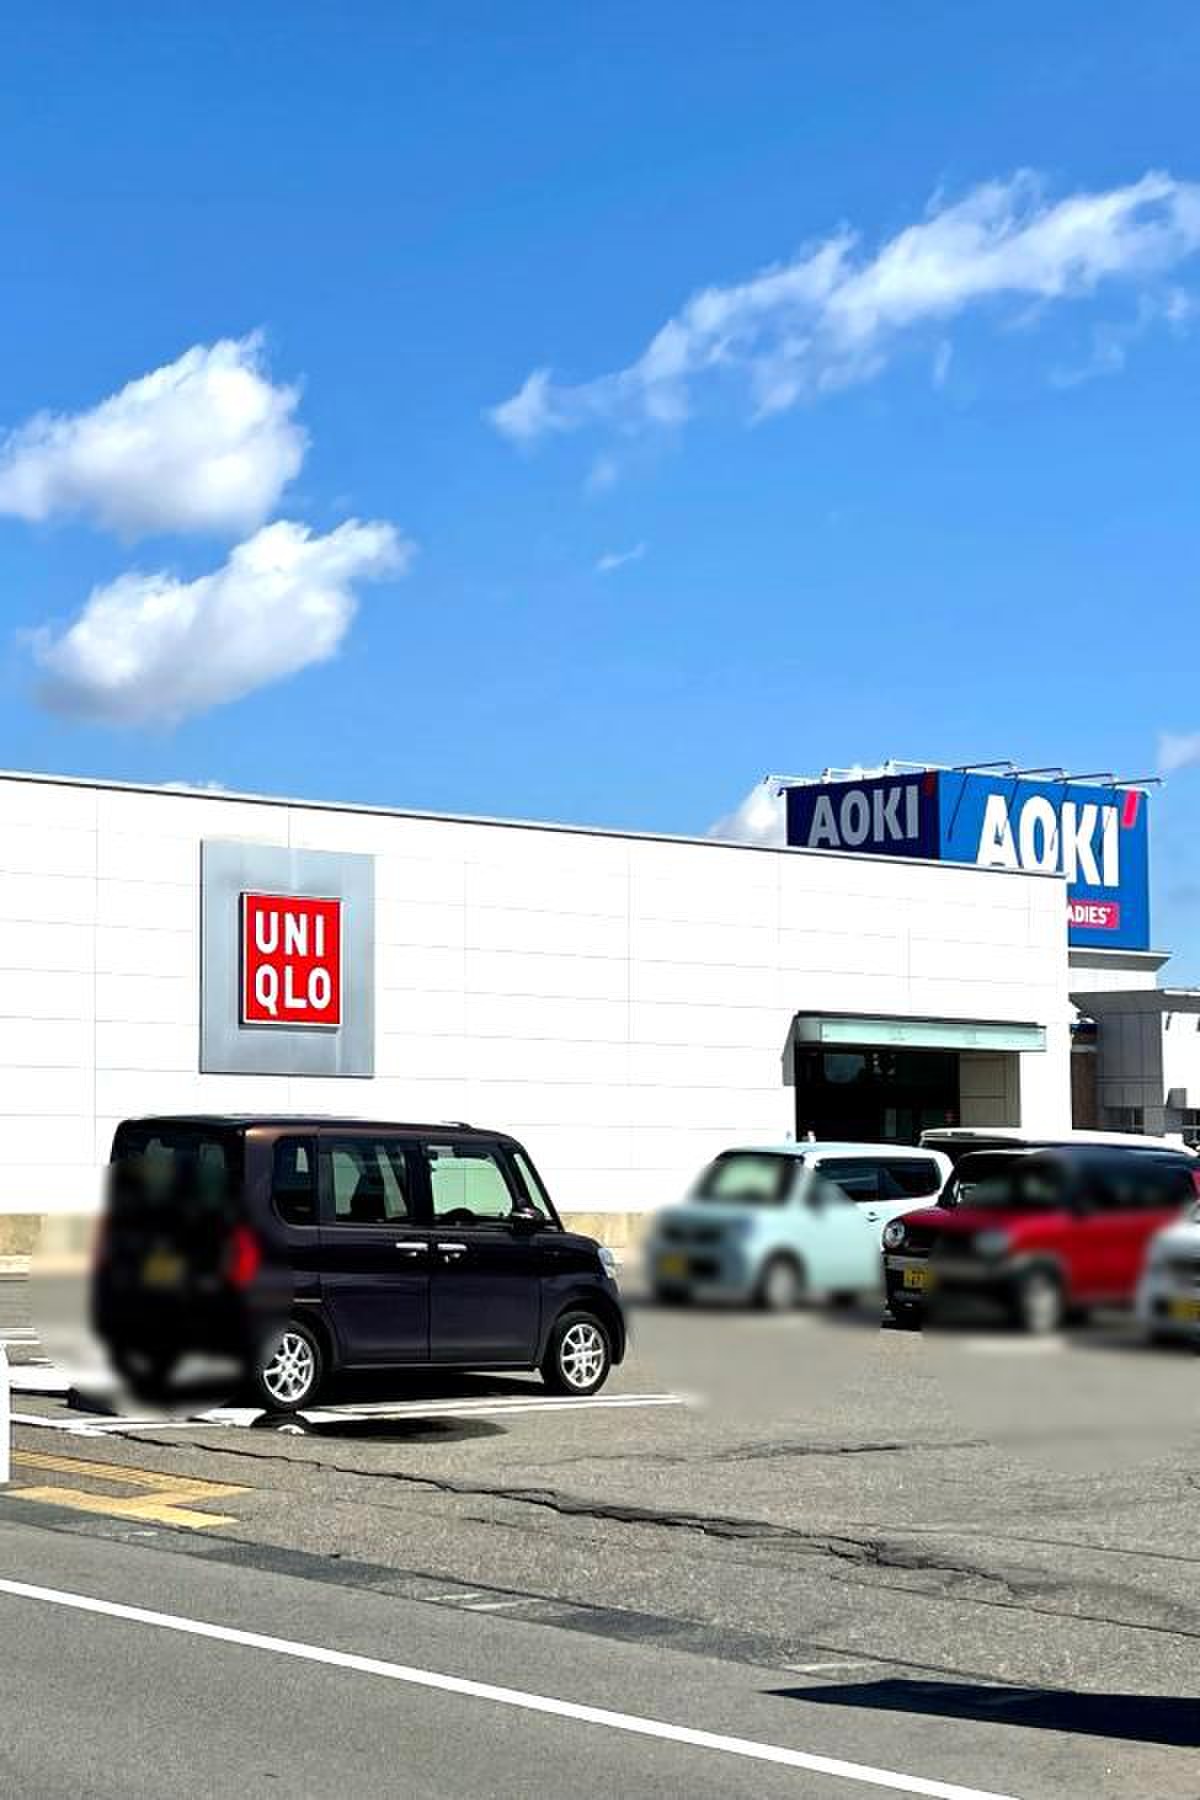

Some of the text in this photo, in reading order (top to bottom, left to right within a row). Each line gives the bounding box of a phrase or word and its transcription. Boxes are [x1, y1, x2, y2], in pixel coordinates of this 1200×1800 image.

[807, 785, 918, 848] AOKI
[976, 794, 1119, 887] AOKI
[255, 910, 324, 957] UNI
[255, 964, 331, 1015] QLO
